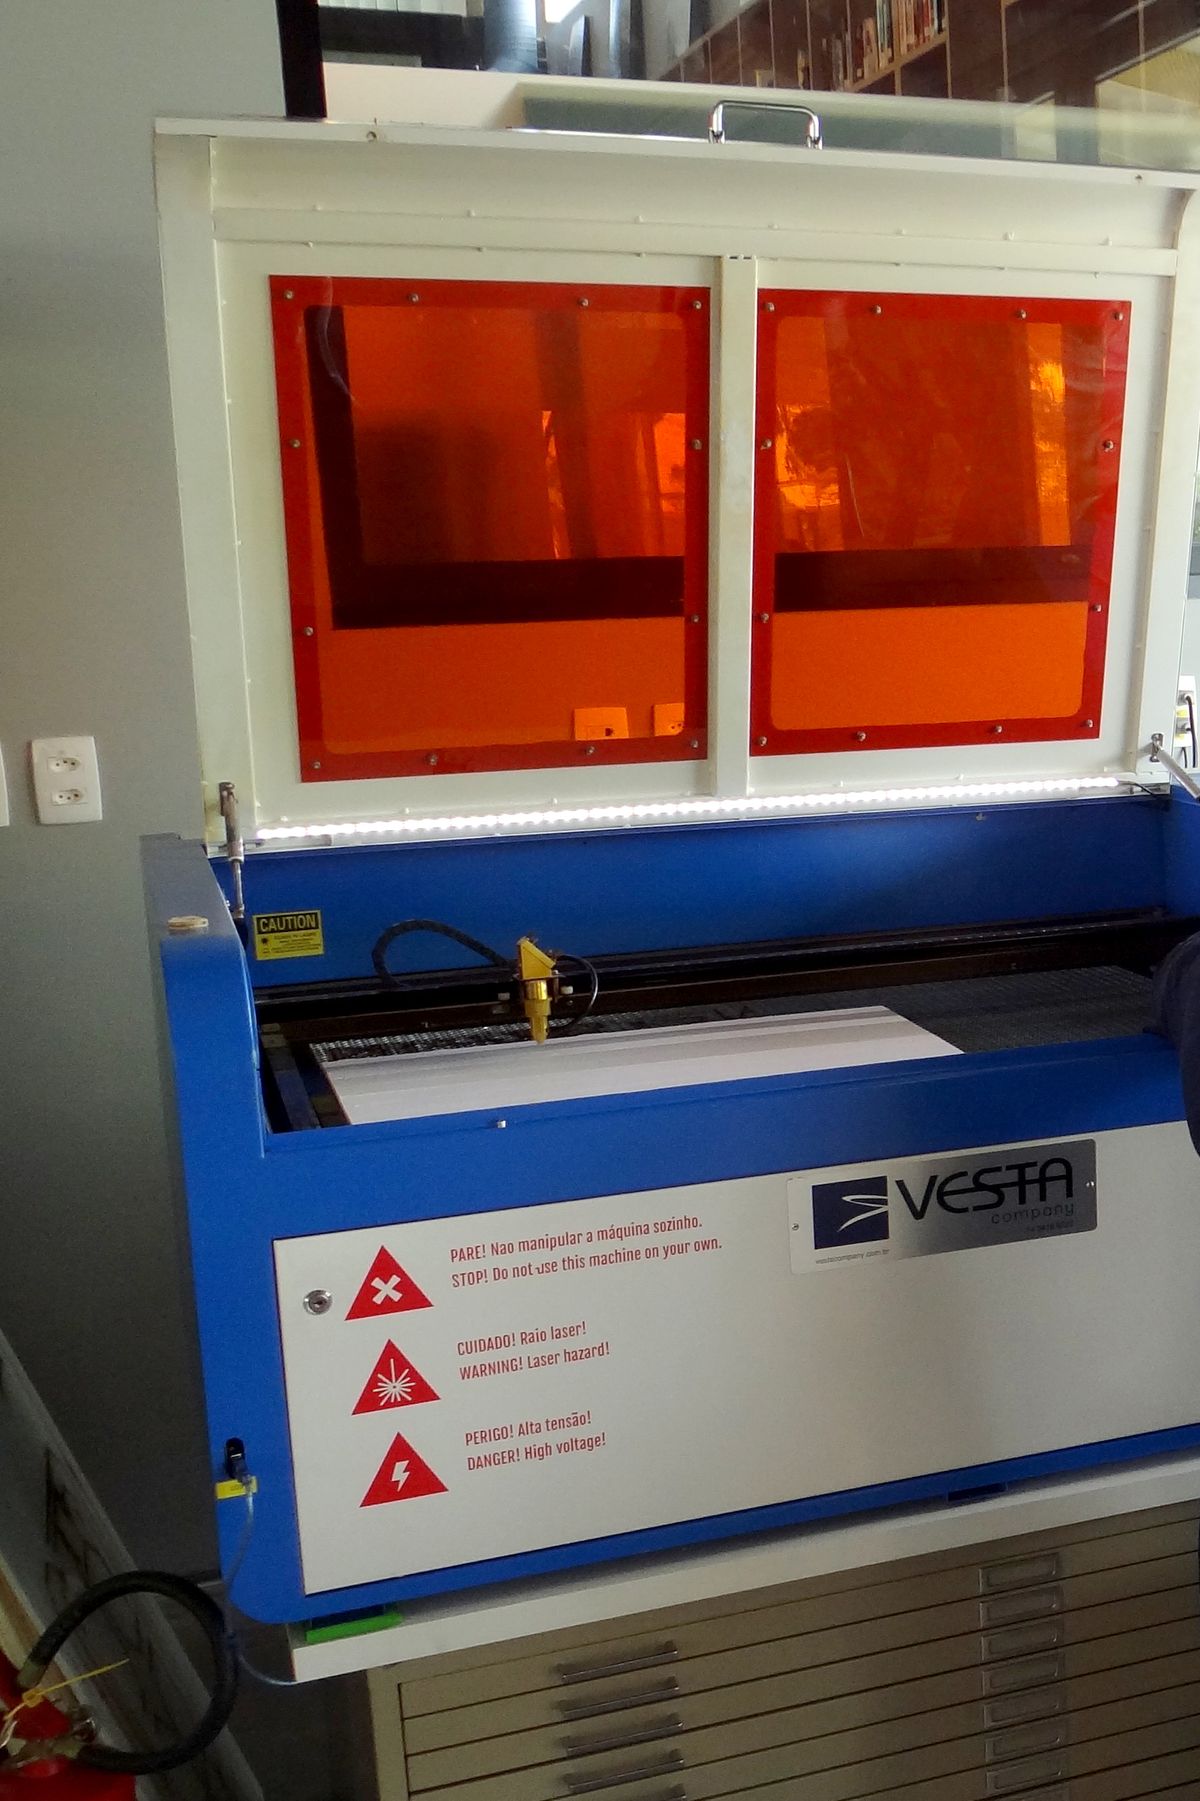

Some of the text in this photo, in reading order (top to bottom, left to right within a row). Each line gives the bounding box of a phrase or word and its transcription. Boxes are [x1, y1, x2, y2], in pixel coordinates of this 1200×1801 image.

[260, 914, 316, 931] CAUTION
[895, 1157, 1073, 1220] VESTA
[992, 1204, 1073, 1224] company
[450, 1244, 486, 1263] PARE!
[518, 1232, 583, 1253] manipular
[586, 1231, 593, 1243] a
[597, 1222, 649, 1241] máquina
[452, 1237, 722, 1288] STOP! Do not use this machine on your own.
[458, 1321, 586, 1356] CUIDADO! Raio laser!
[460, 1342, 610, 1380] WARNING! Laser hazard!
[465, 1410, 592, 1446] PERIGO! Alta tensão!
[467, 1432, 606, 1471] DANGER! High voltage!
